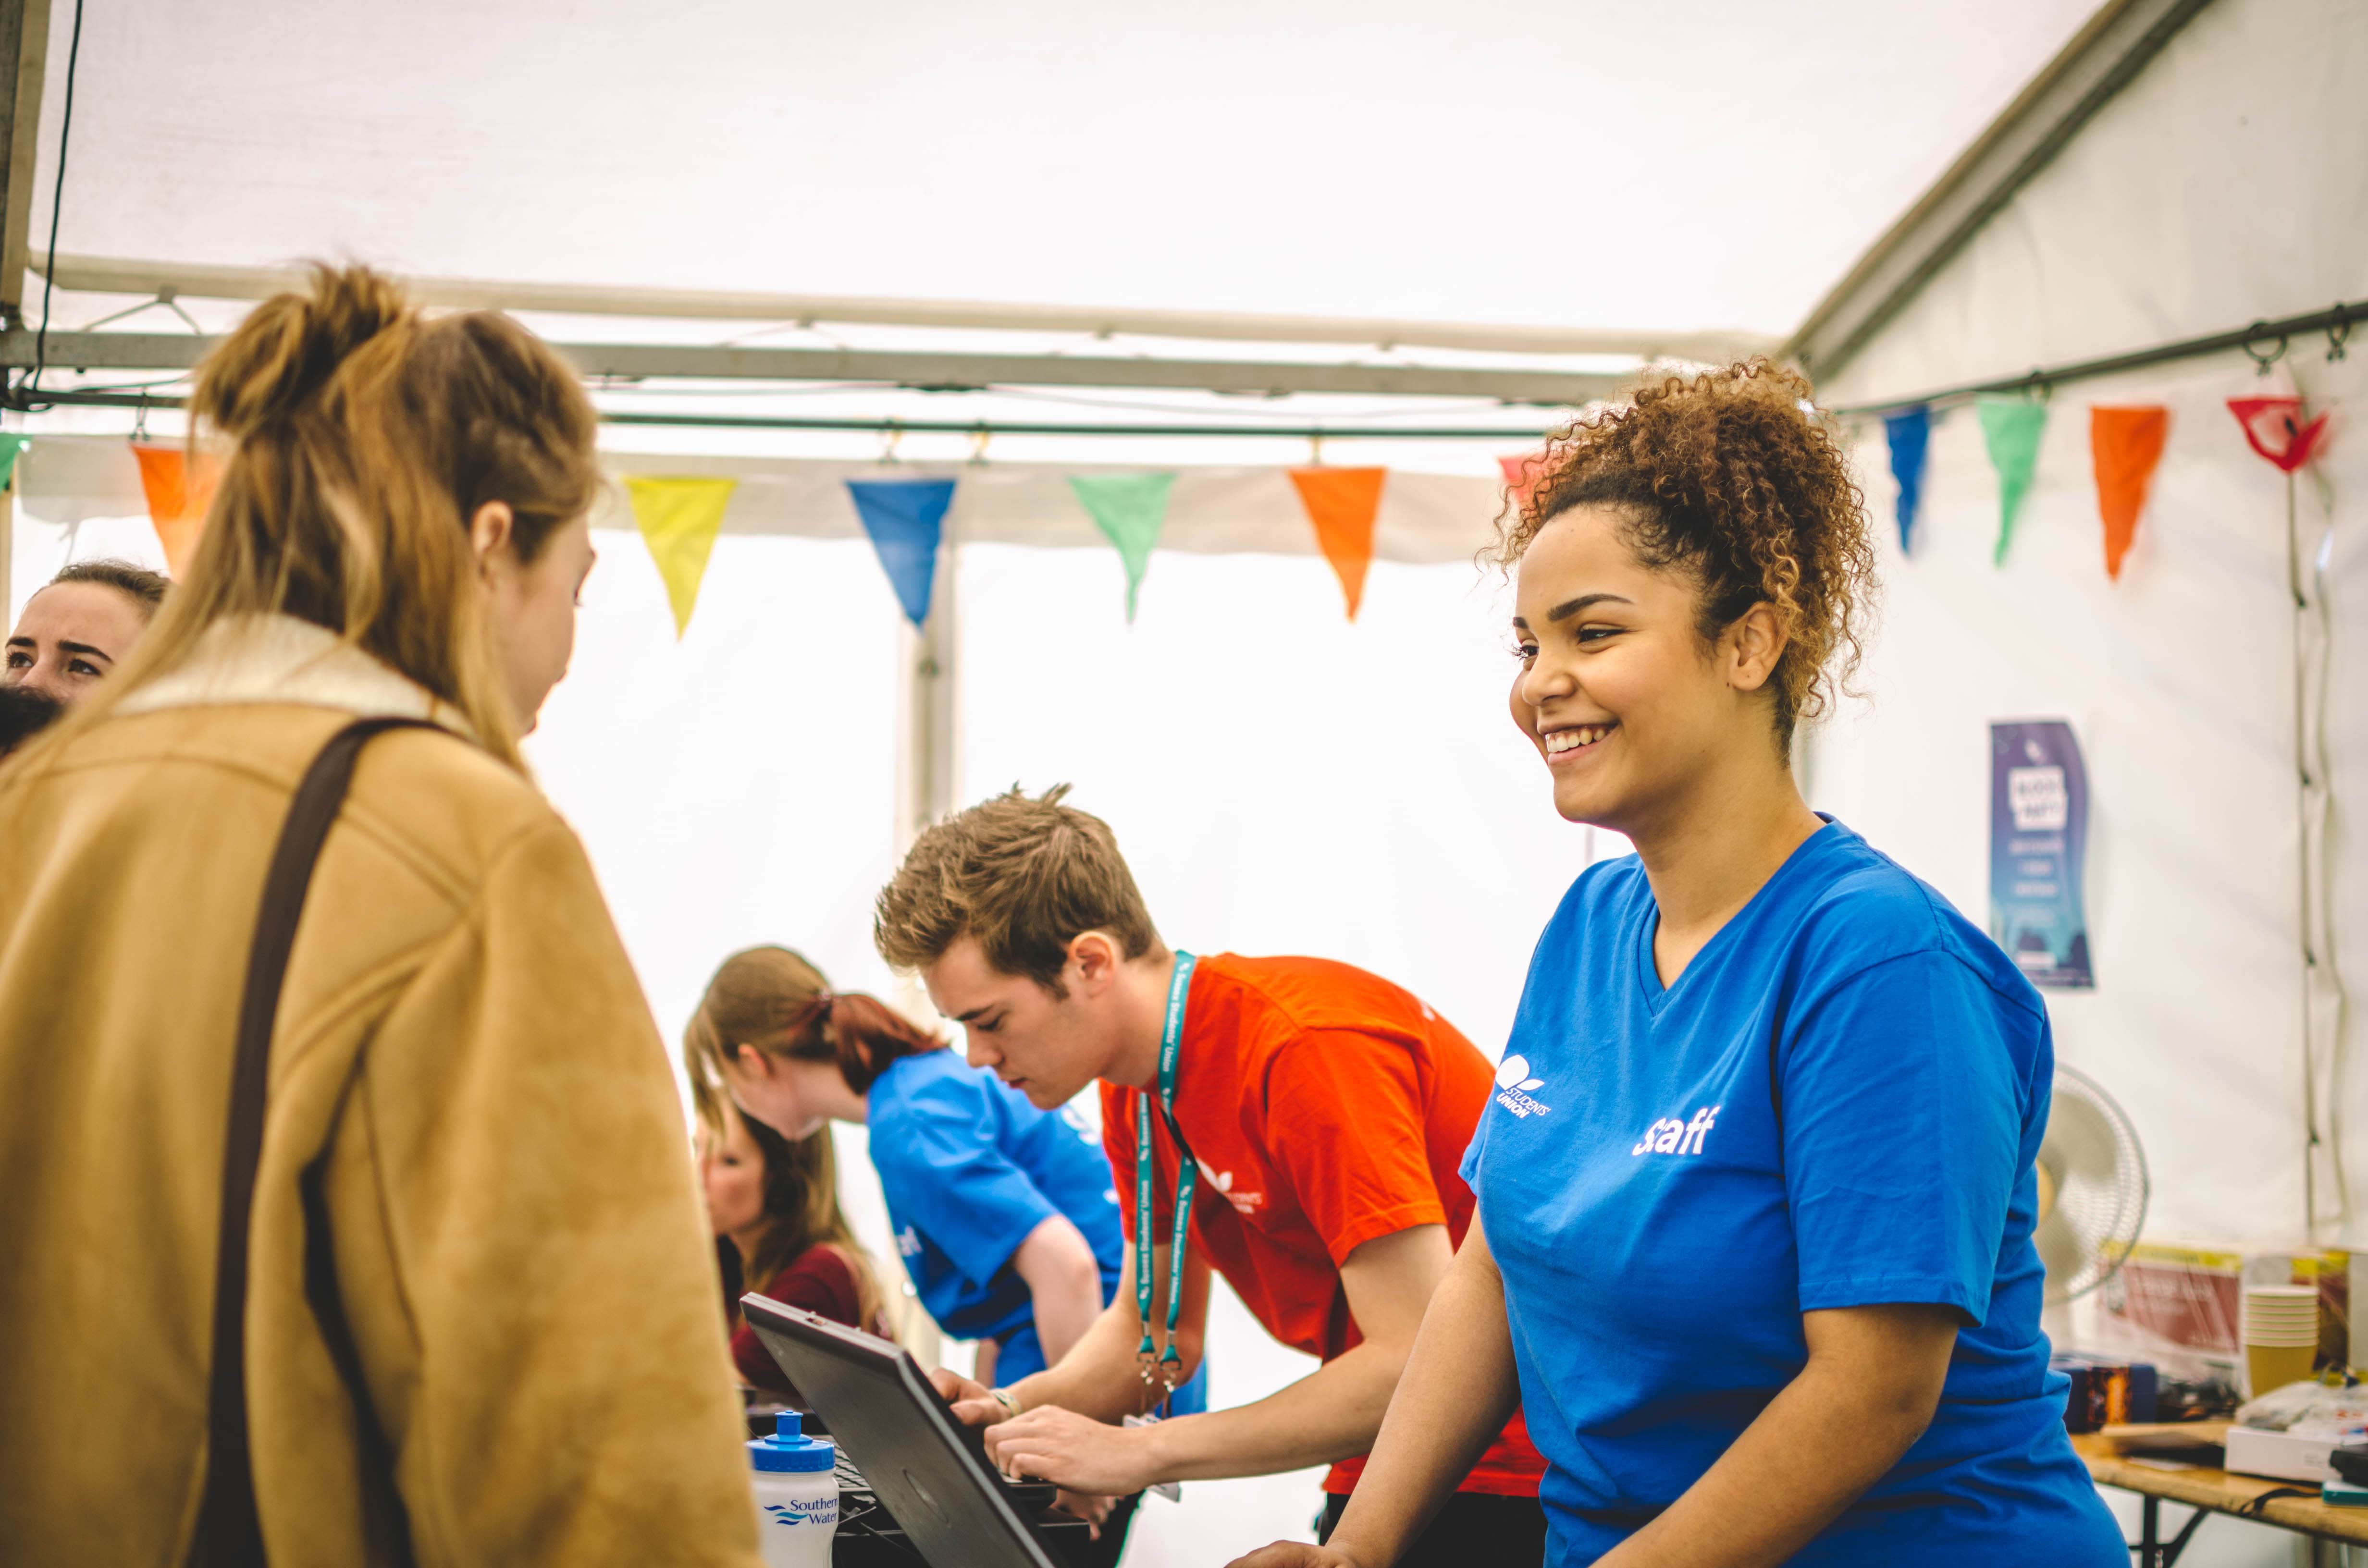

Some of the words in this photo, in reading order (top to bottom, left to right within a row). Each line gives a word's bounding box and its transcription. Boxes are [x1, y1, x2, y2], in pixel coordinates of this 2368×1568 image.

[1162, 1046, 1174, 1072] Union
[1496, 1092, 1530, 1118] UNION
[1505, 1088, 1552, 1116] STUDENTS'
[1632, 1106, 1721, 1156] saff
[1141, 1180, 1149, 1208] Union
[790, 1497, 838, 1511] Southern
[808, 1512, 837, 1525] Water
